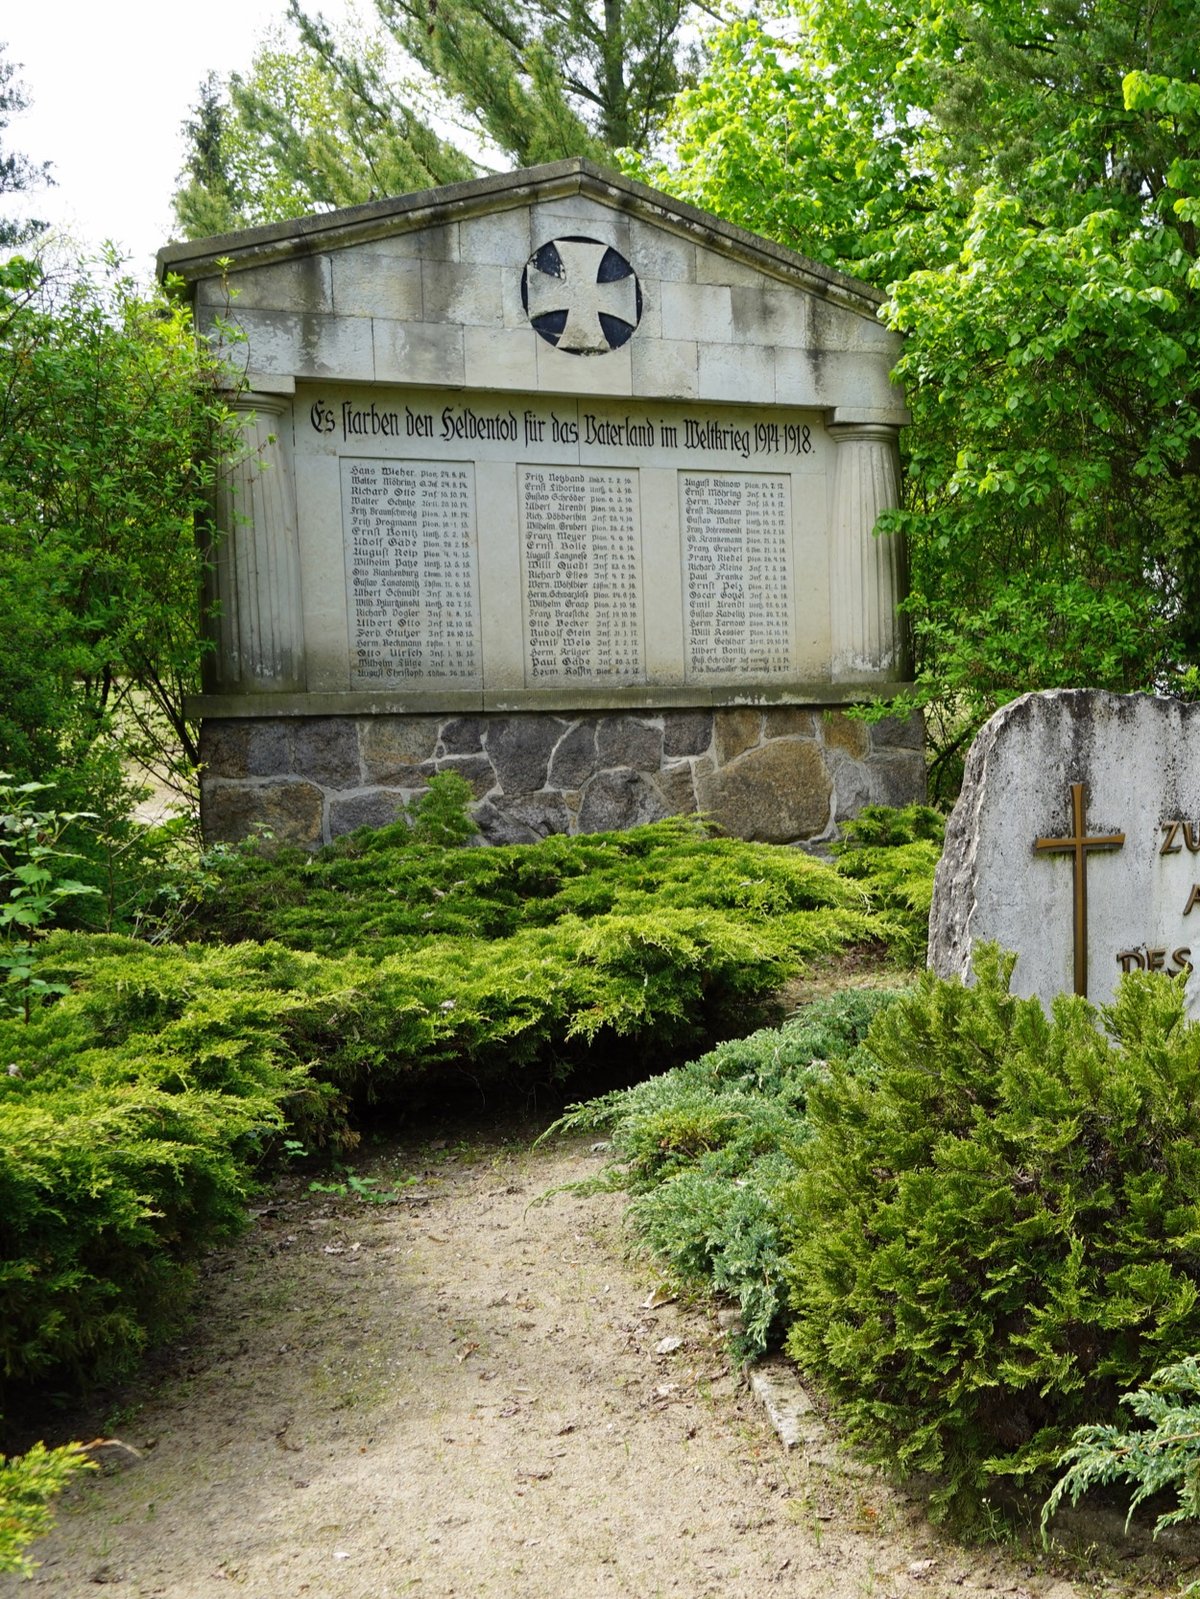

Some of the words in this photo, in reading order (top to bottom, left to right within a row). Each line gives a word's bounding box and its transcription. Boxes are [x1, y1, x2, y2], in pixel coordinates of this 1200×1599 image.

[311, 400, 335, 433] Es
[406, 406, 433, 437] den
[440, 407, 517, 441] Heldentod
[524, 410, 546, 448] für
[551, 411, 578, 443] das
[584, 415, 654, 447] Vaterland
[660, 420, 677, 448] im
[683, 419, 750, 458] Weltkrieg
[350, 466, 375, 476] Hans
[525, 473, 544, 483] Fritz
[351, 487, 388, 495] Richard
[394, 488, 415, 496] Otto
[525, 483, 545, 492] Ernst
[351, 497, 379, 505] Walter
[525, 502, 549, 510] Albert
[352, 527, 380, 536] Ernst
[557, 532, 586, 542] Meyer
[527, 541, 553, 549] Ernst
[353, 548, 388, 558] August
[353, 558, 389, 566] Wilhelm
[352, 568, 368, 576] Otto
[529, 571, 560, 579] Richard
[690, 573, 707, 581] Paul
[689, 581, 714, 591] Ernst
[353, 588, 380, 596] Albert
[356, 609, 386, 617] Richard
[357, 619, 391, 627] Albert
[398, 618, 420, 627] Otto
[529, 619, 549, 627] Otto
[531, 629, 563, 638] Rudolf
[357, 649, 380, 657] Otto
[532, 657, 556, 667] Paul
